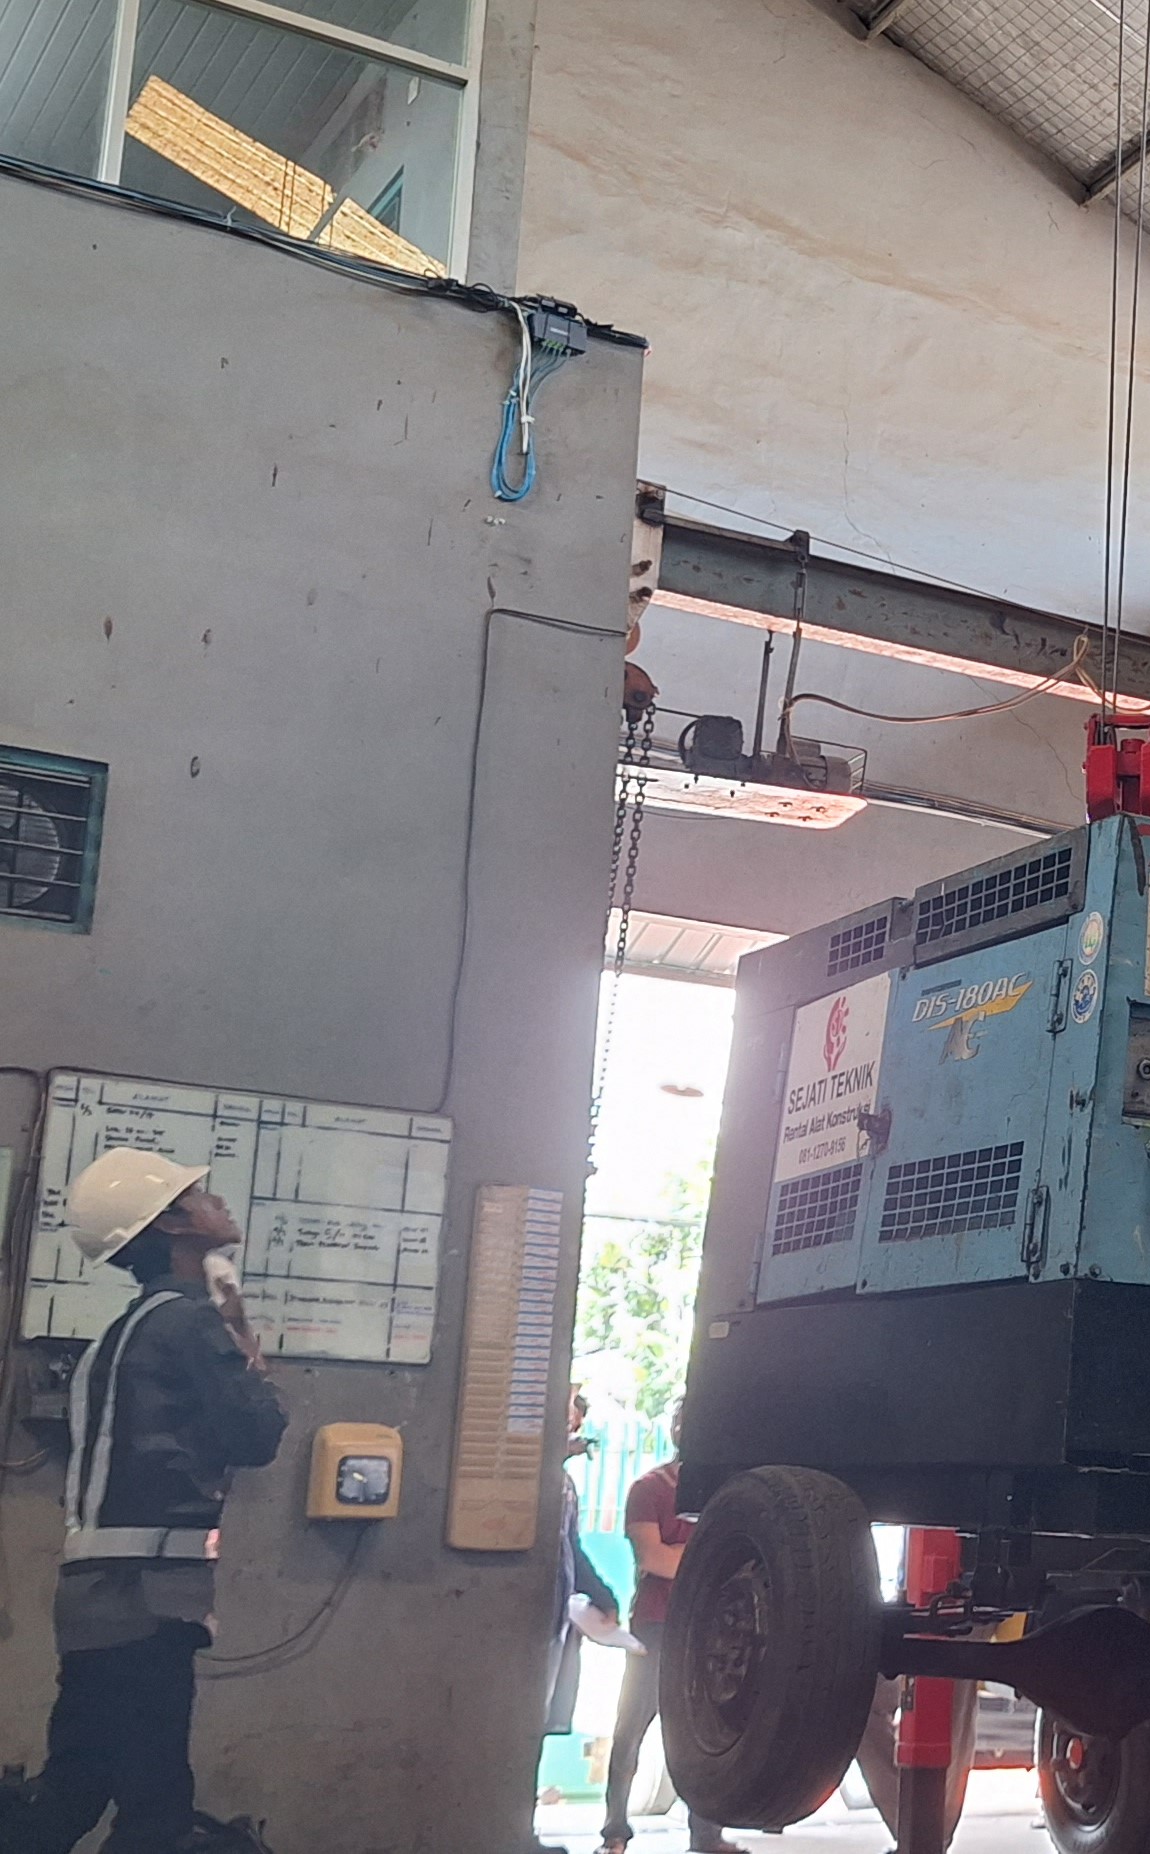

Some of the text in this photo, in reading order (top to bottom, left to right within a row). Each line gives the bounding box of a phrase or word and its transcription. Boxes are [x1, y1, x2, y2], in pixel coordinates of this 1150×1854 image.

[912, 972, 1027, 1022] DIS-180AC
[788, 1060, 876, 1115] SEJATI TEKNIK
[783, 1119, 809, 1144] Rental
[809, 1114, 825, 1136] Alat
